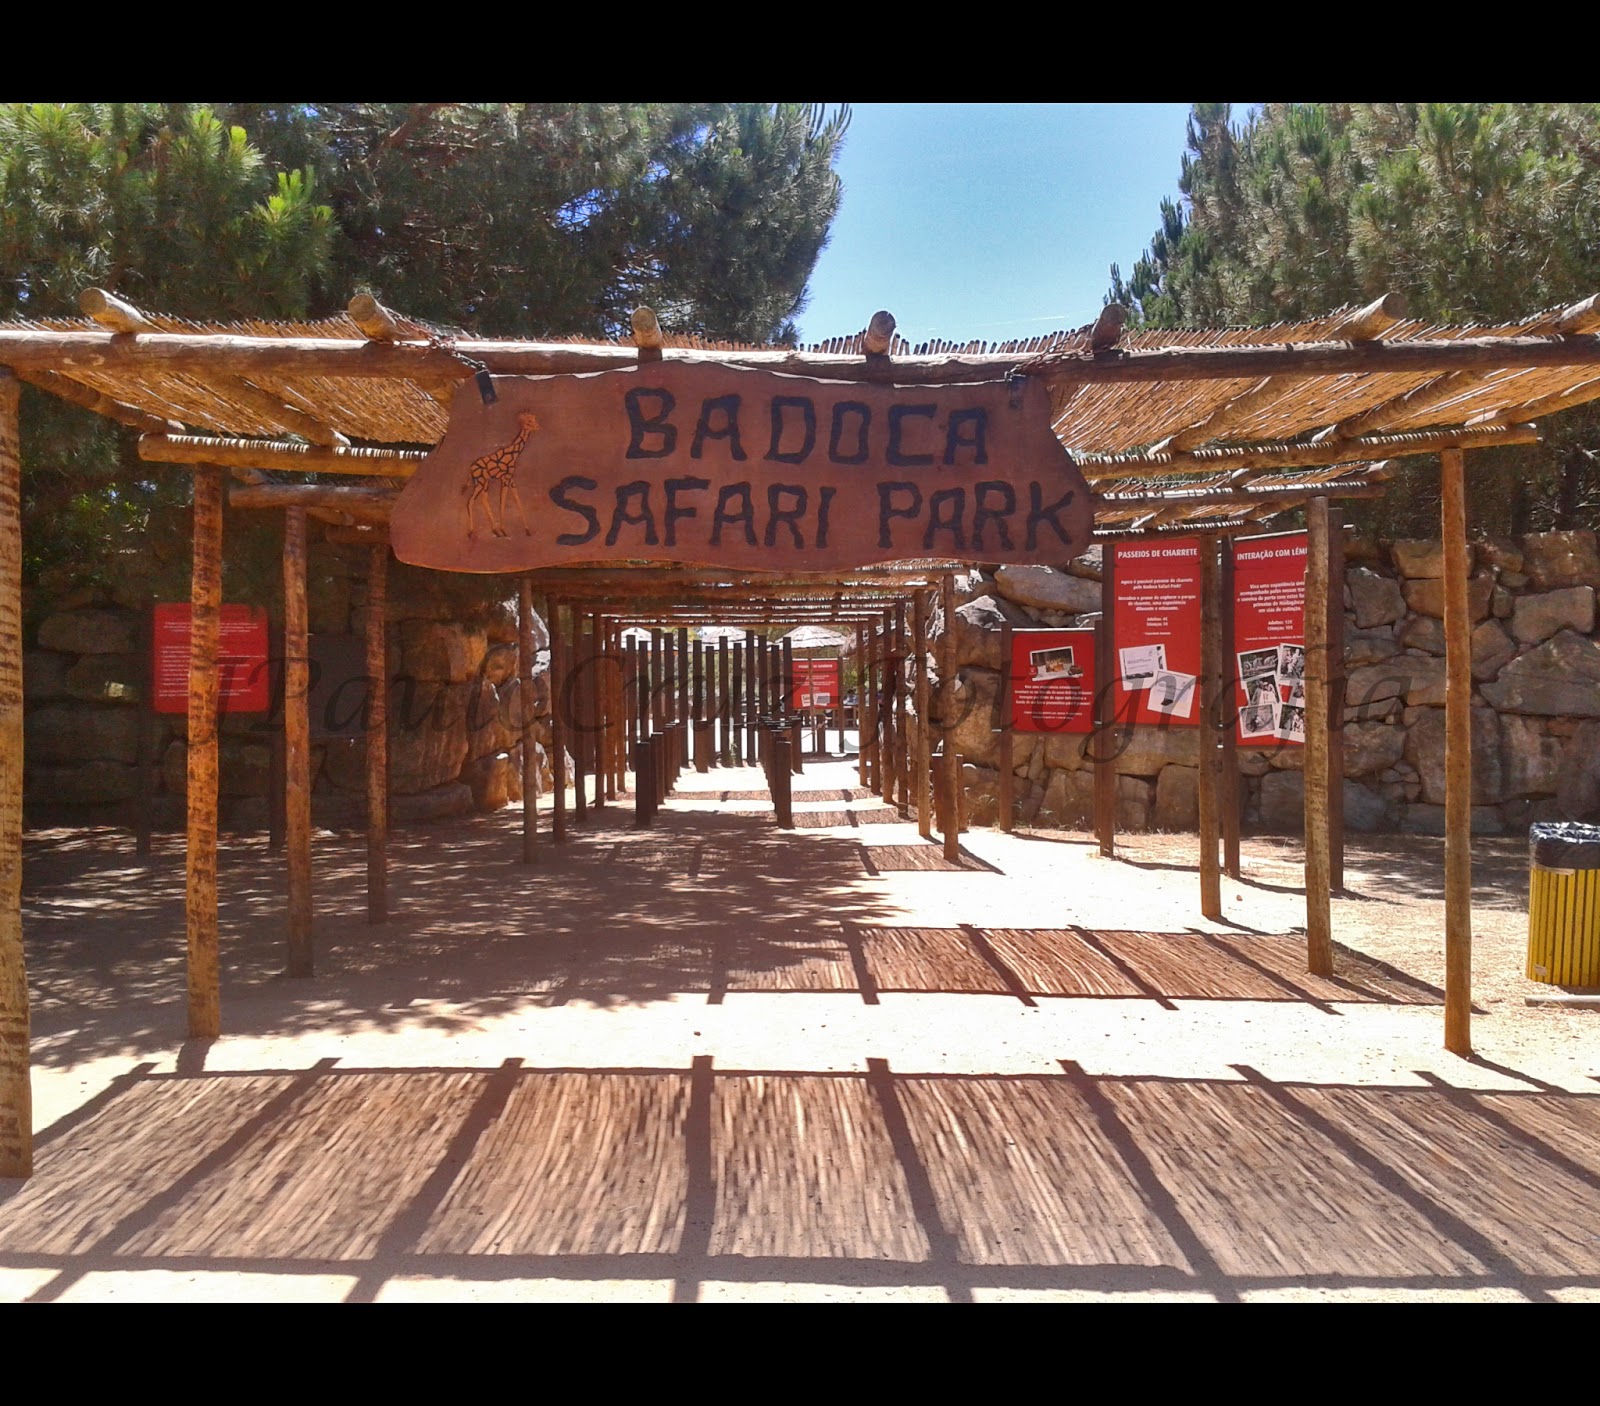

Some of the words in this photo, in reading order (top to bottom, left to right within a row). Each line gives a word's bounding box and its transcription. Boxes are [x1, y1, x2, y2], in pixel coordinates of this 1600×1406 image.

[624, 386, 989, 465] BADOCA
[548, 475, 838, 548] SAFARI
[876, 480, 1076, 552] PARK
[1117, 550, 1150, 559] PASSEIOS
[1151, 549, 1161, 557] DE
[1162, 548, 1198, 557] CHARRETE
[1236, 549, 1274, 560] INTERAÇÃO
[1274, 549, 1291, 557] COM
